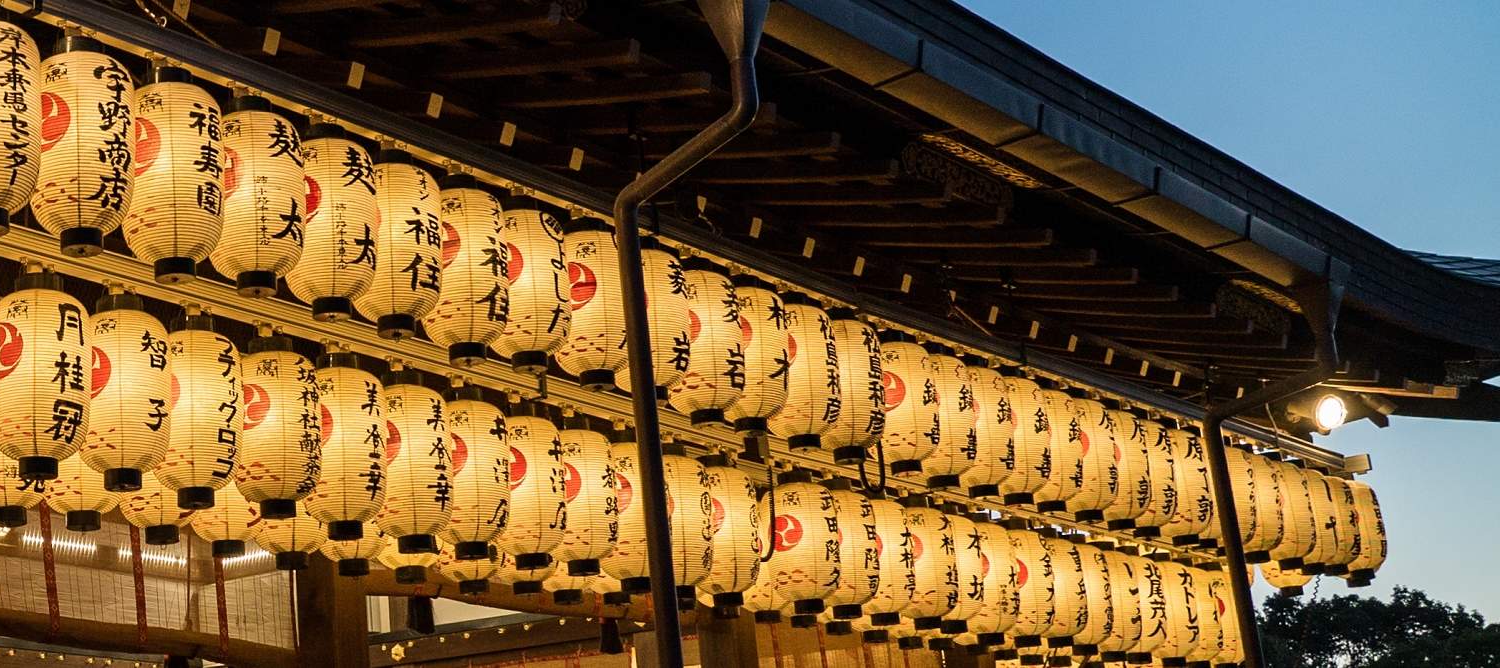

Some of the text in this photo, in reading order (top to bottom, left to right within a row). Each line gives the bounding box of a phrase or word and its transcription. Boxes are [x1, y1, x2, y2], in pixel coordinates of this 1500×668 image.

[86, 59, 132, 211] 宇野商店
[189, 103, 222, 216] 福寿園
[401, 207, 442, 291] 福住
[45, 304, 85, 445] 月桂冠
[140, 330, 169, 432] 智子
[1144, 562, 1167, 640] 北尾茂人
[1178, 567, 1200, 643] カトレア
